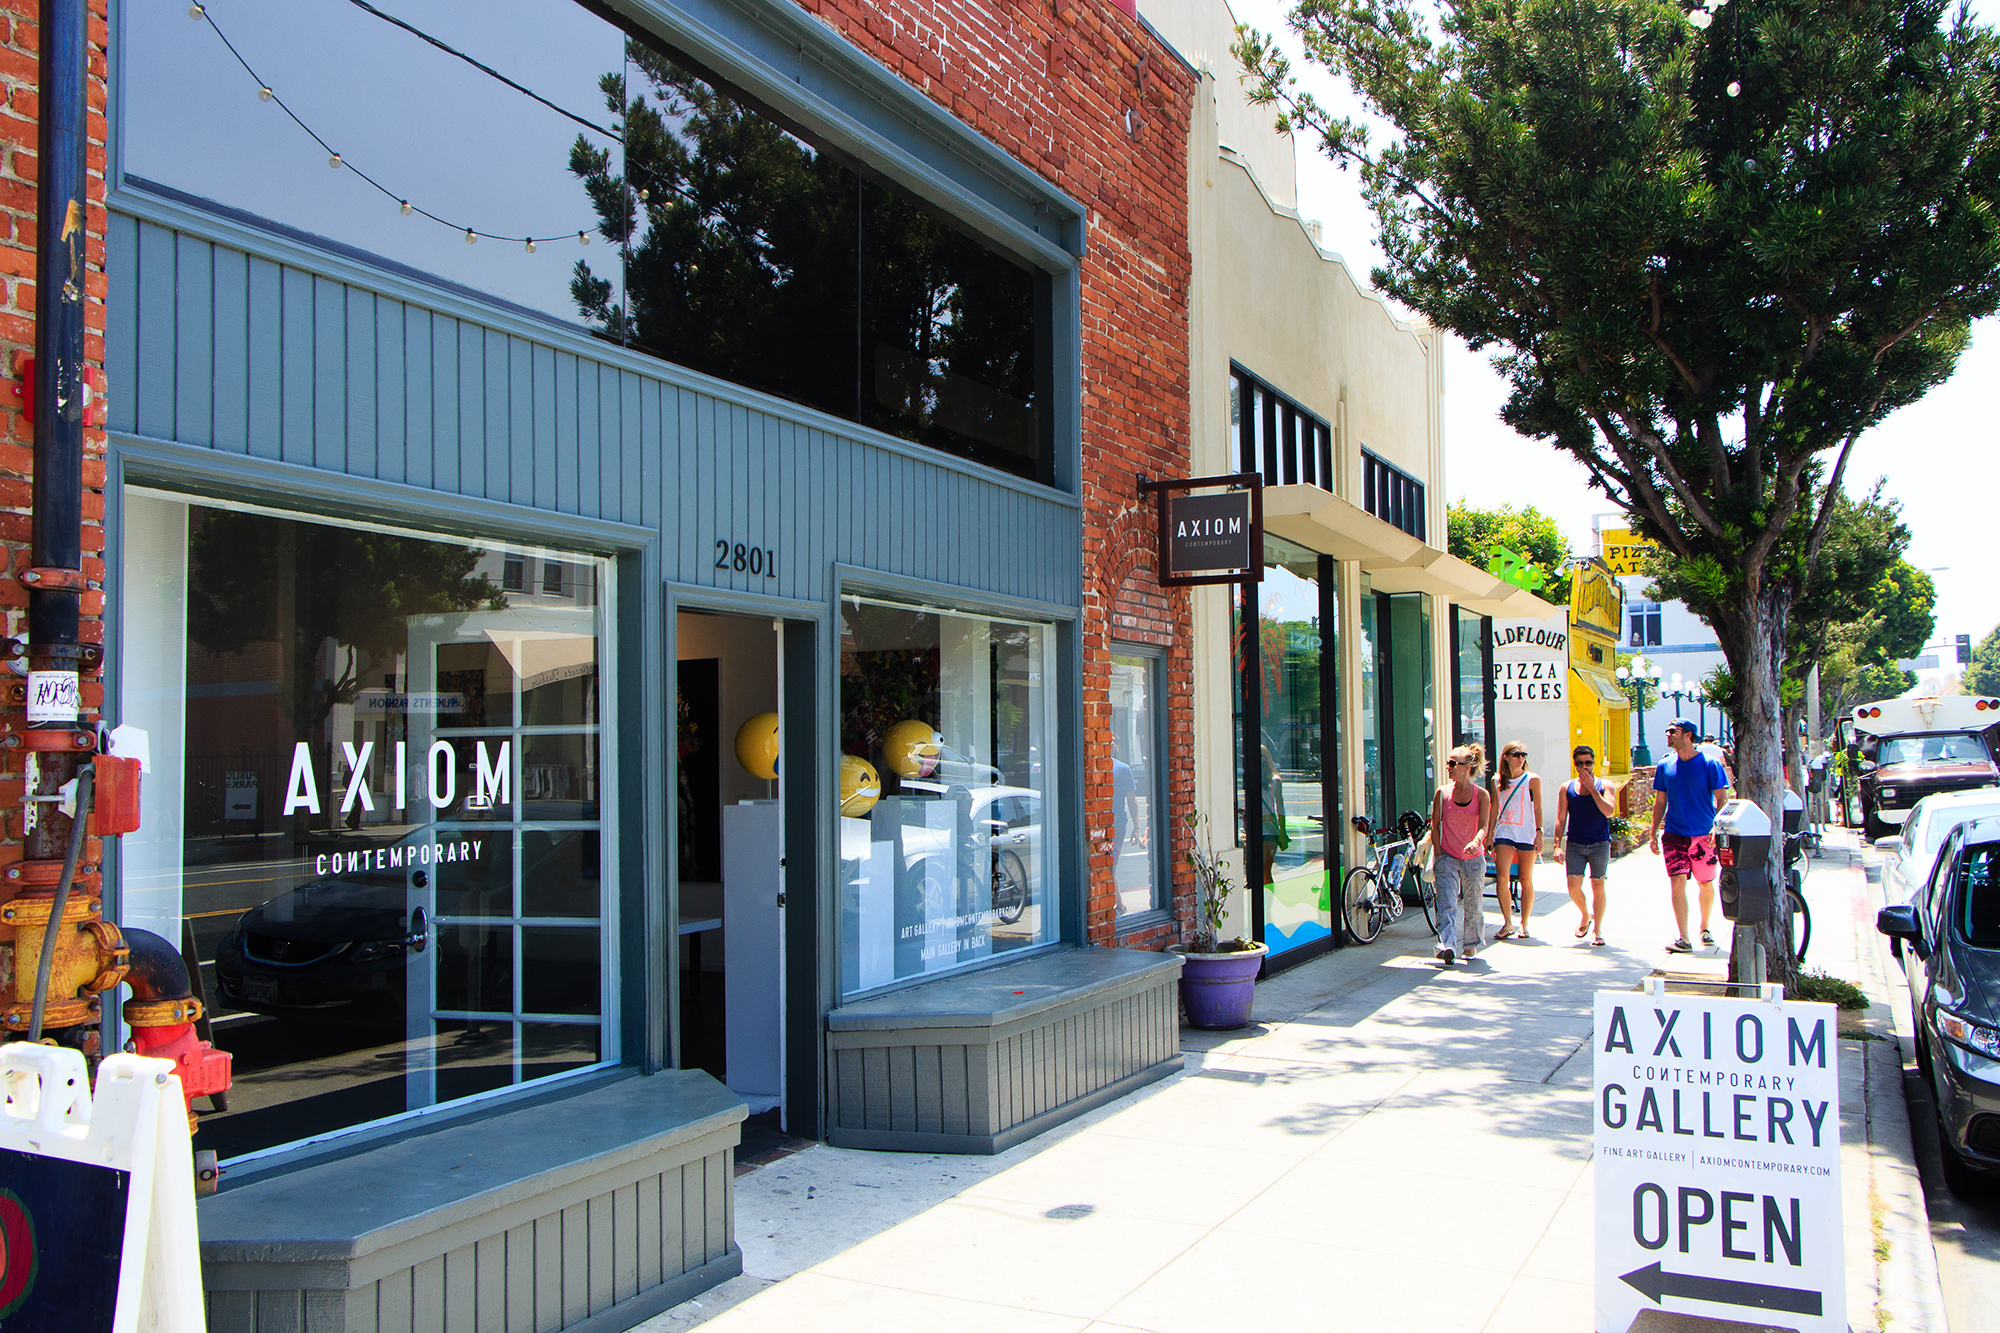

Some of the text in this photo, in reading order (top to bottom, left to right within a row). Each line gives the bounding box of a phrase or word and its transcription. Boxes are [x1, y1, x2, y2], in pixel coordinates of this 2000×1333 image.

[1177, 516, 1240, 538] AXIOM
[1185, 539, 1232, 548] CONTEMPORARY
[1609, 546, 1643, 559] PIZ
[715, 539, 776, 578] 2801
[1493, 625, 1567, 651] LDFLOUR
[1493, 662, 1557, 680] PIZZA
[283, 740, 511, 816] AXIOM
[315, 840, 483, 876] CONTEMPORARY
[901, 926, 913, 940] ART
[920, 934, 986, 962] MAIN GALLERY IN BACK
[1604, 1005, 1826, 1069] AXIOM
[1633, 1064, 1795, 1092] CONTEMPORARY
[1602, 1082, 1829, 1148] GALLERY
[1603, 1146, 1831, 1177] FINE ART GALLERY AXIOMCONTEMPORARY.COM
[1633, 1182, 1802, 1267] OPEN
